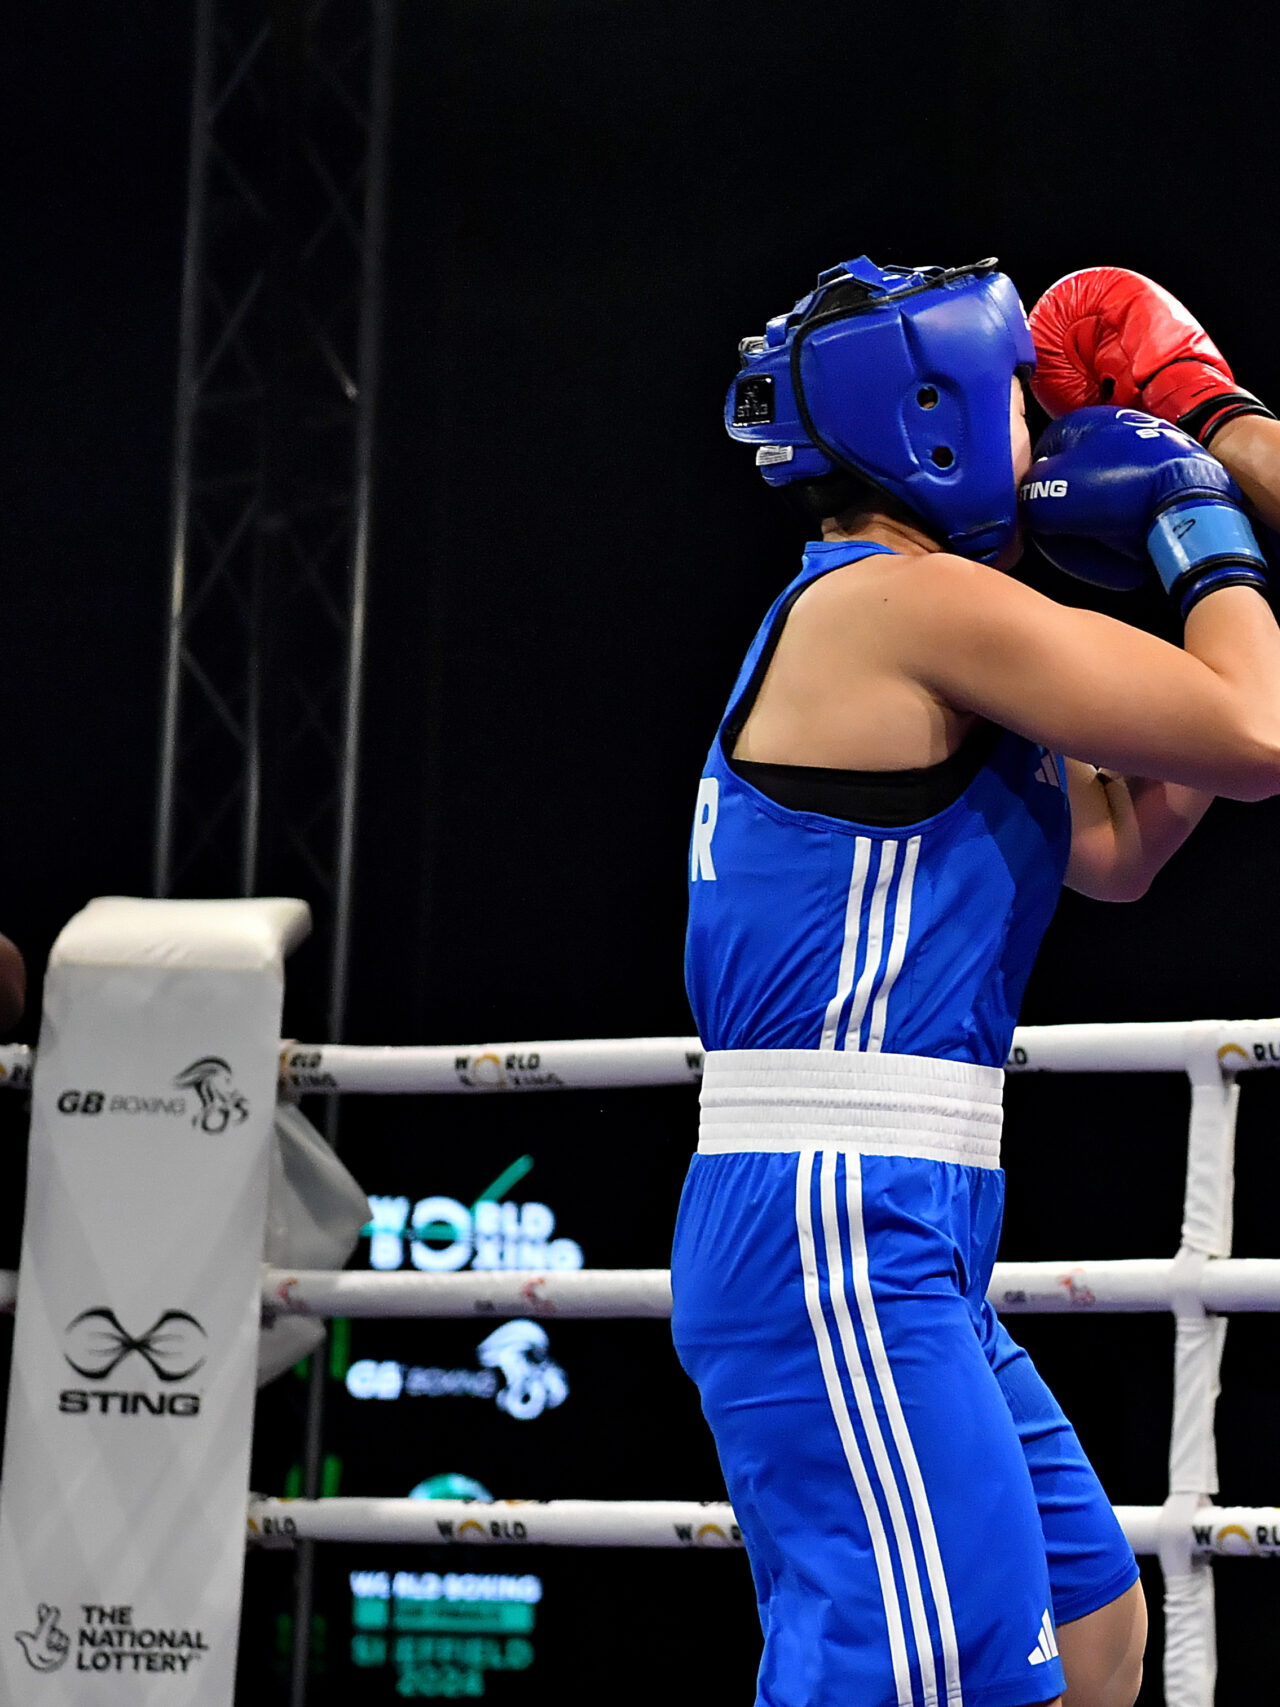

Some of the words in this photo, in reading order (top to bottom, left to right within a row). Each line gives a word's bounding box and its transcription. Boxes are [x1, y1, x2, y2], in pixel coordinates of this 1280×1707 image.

[1020, 479, 1068, 501] TING
[57, 1089, 105, 1115] GB
[58, 1388, 201, 1417] STING
[82, 1604, 132, 1625] THE
[79, 1627, 209, 1651] NATIONAL
[77, 1651, 196, 1673] LOTTERY
